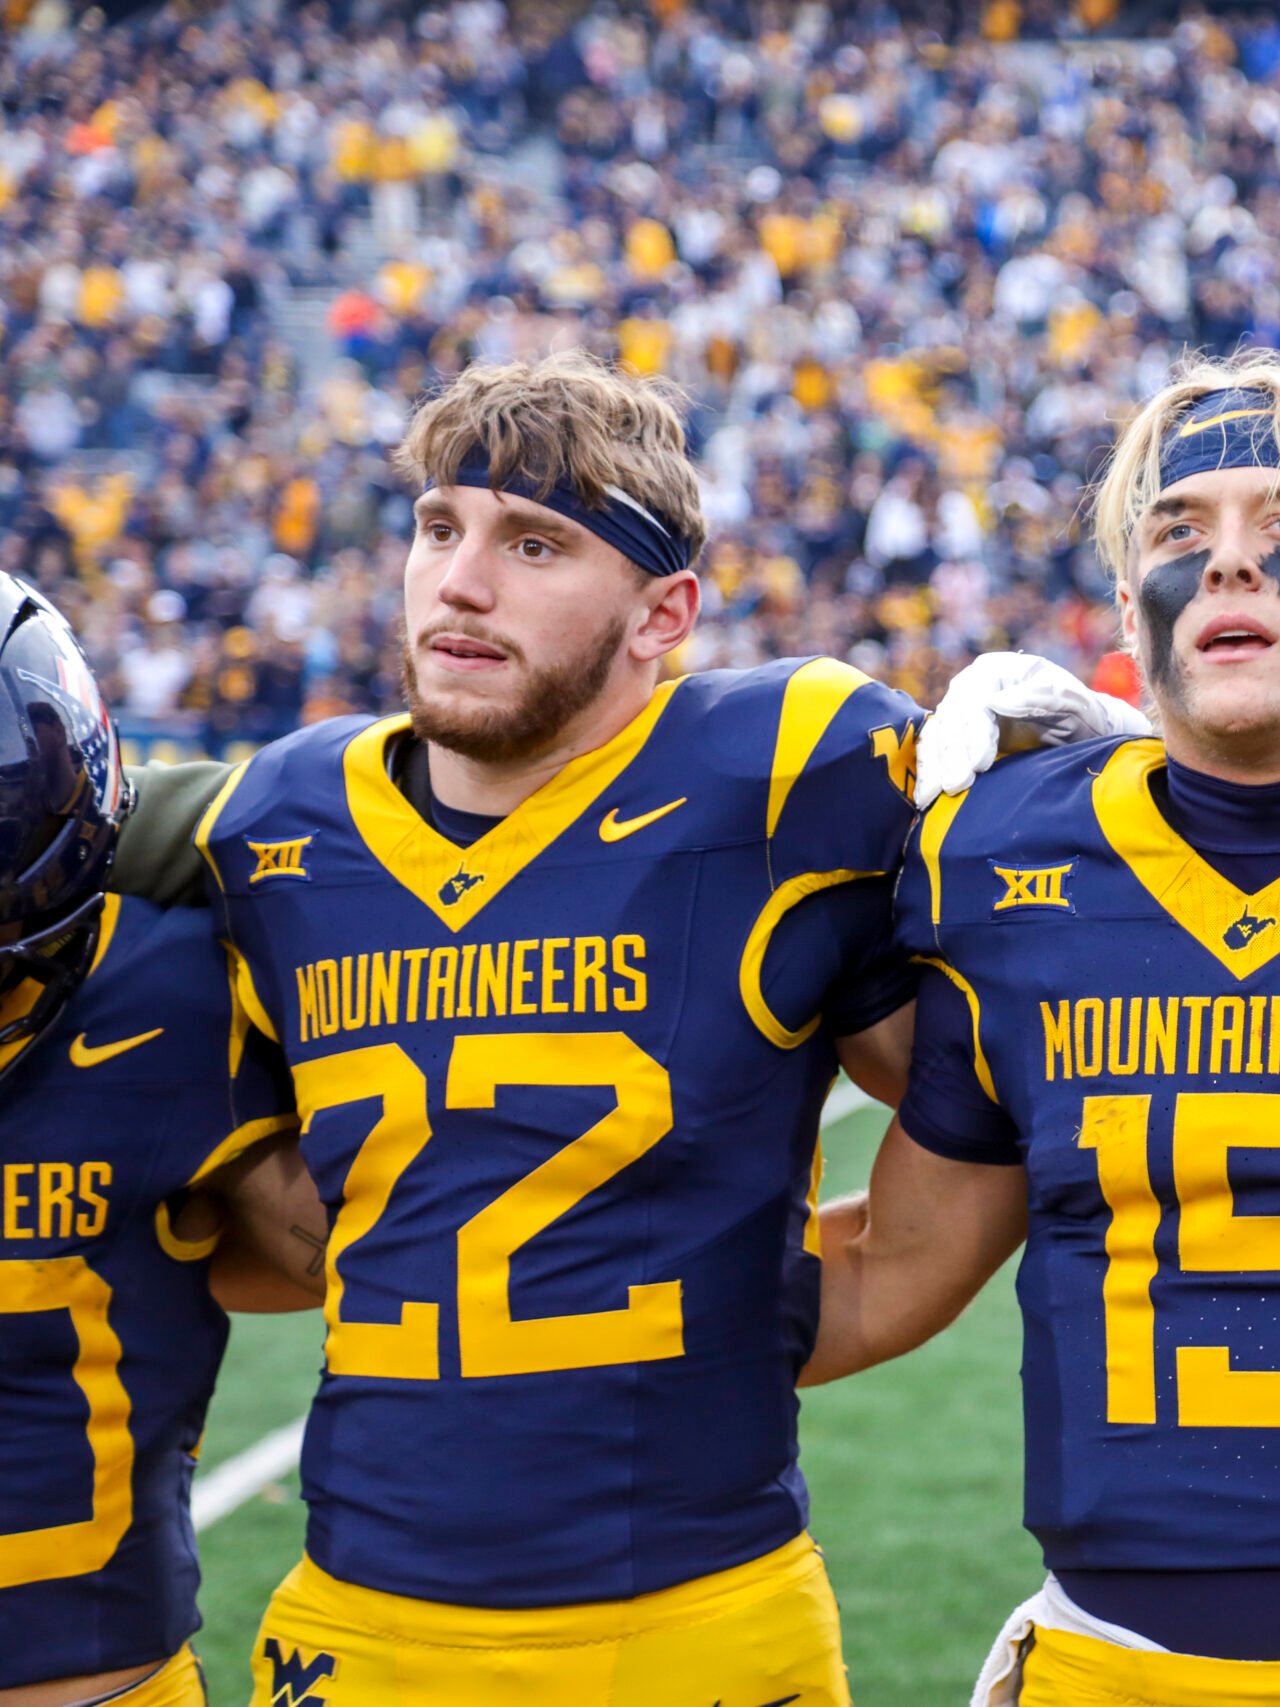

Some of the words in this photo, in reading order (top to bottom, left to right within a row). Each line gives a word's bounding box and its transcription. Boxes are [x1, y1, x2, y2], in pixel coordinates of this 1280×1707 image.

[248, 836, 313, 884] XII
[994, 863, 1073, 911] XII
[295, 933, 648, 1043] MOUNTAINEERS
[291, 1031, 687, 1381] 22
